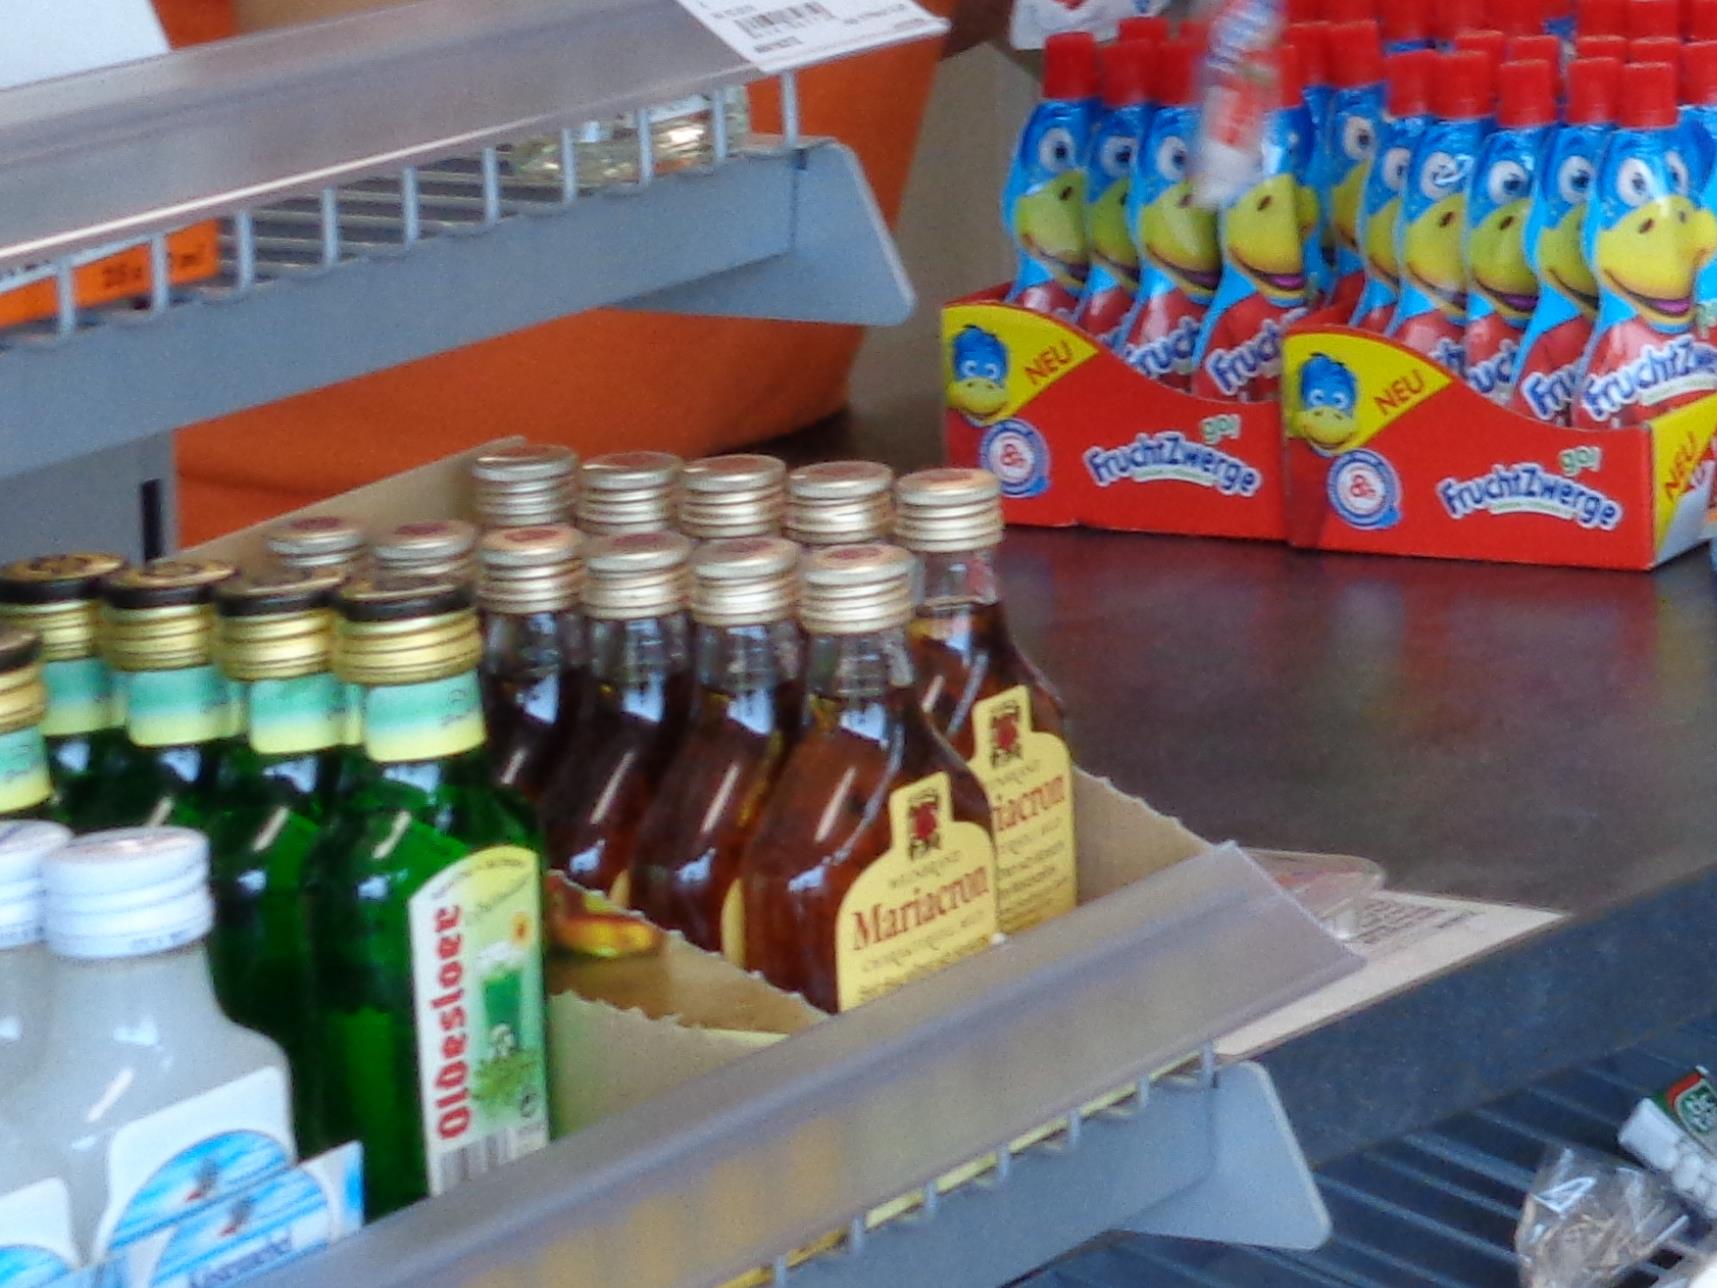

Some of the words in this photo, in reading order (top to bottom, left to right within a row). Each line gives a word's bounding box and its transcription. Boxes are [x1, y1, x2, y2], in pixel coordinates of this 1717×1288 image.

[1024, 340, 1075, 385] NEU
[1374, 369, 1425, 416] NEU
[1083, 431, 1263, 497] FruchtZwerge
[1559, 445, 1601, 476] go!
[1664, 431, 1698, 500] NEU
[1437, 462, 1623, 531] FruchtZwerge
[851, 865, 990, 951] Mariacron
[431, 904, 471, 1141] Oldesloer
